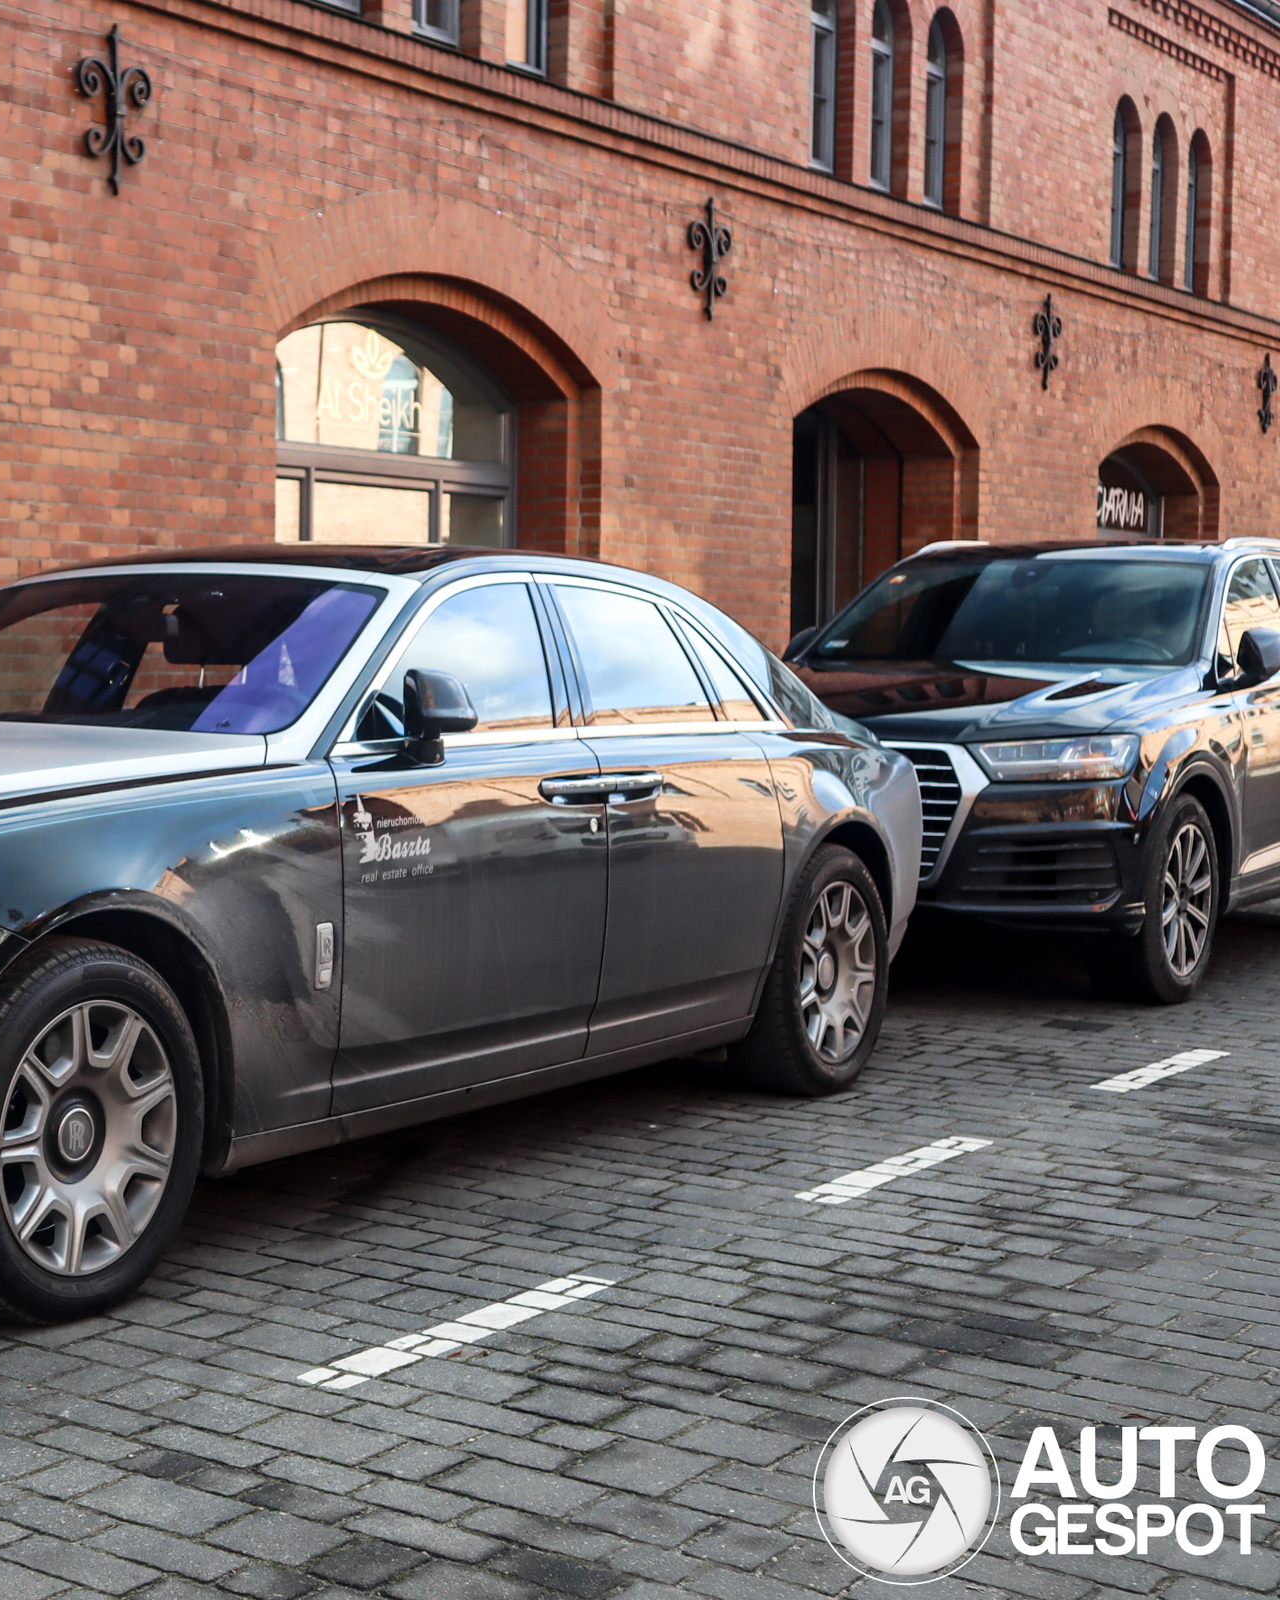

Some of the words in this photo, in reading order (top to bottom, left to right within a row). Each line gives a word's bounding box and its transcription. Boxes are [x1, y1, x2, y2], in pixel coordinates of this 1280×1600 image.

[316, 377, 342, 419] Al
[348, 381, 423, 430] Sheikh
[374, 832, 432, 862] Baszta
[361, 870, 379, 884] real
[382, 867, 408, 881] estate
[411, 863, 434, 877] office
